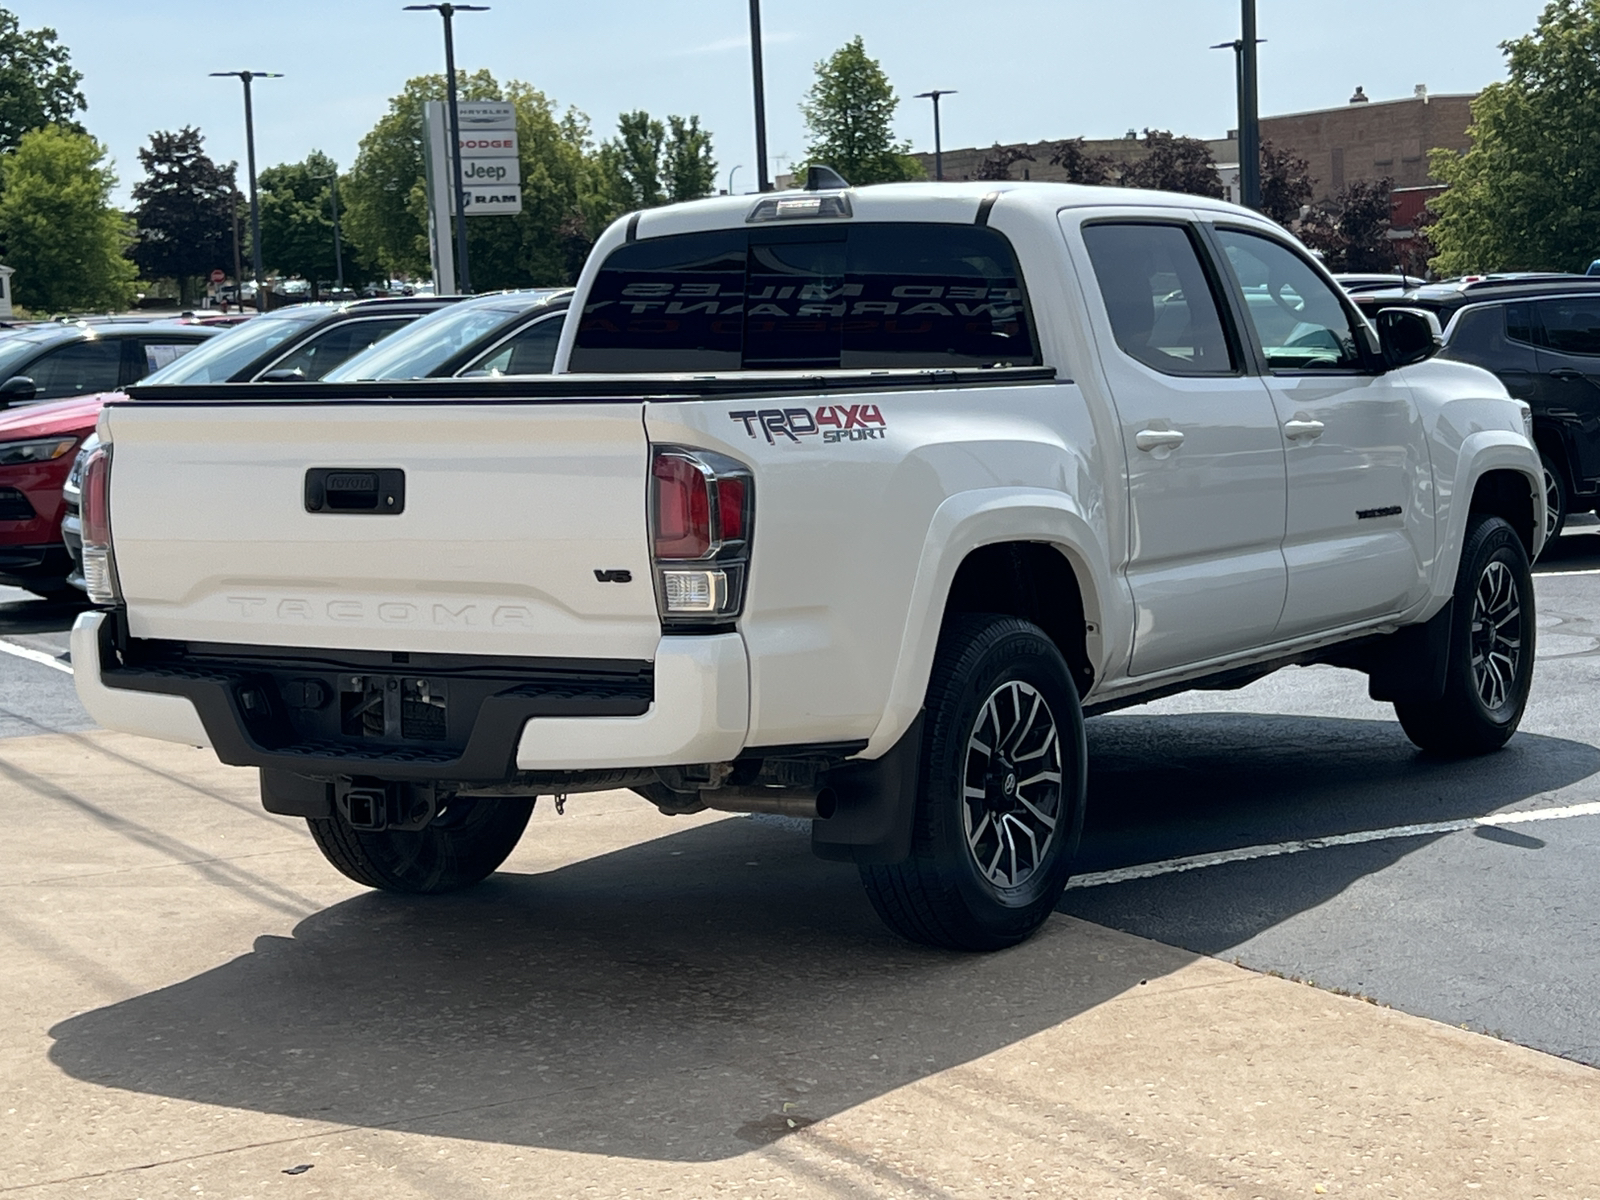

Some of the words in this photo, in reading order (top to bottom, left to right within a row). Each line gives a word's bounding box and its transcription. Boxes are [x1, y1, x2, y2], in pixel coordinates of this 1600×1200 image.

[464, 162, 506, 181] Jeep
[475, 195, 517, 204] RAM
[728, 408, 819, 445] TRD
[823, 427, 887, 443] SPORT
[330, 476, 374, 490] TOYOTA
[593, 569, 632, 583] V6
[227, 596, 534, 629] TACOMA
